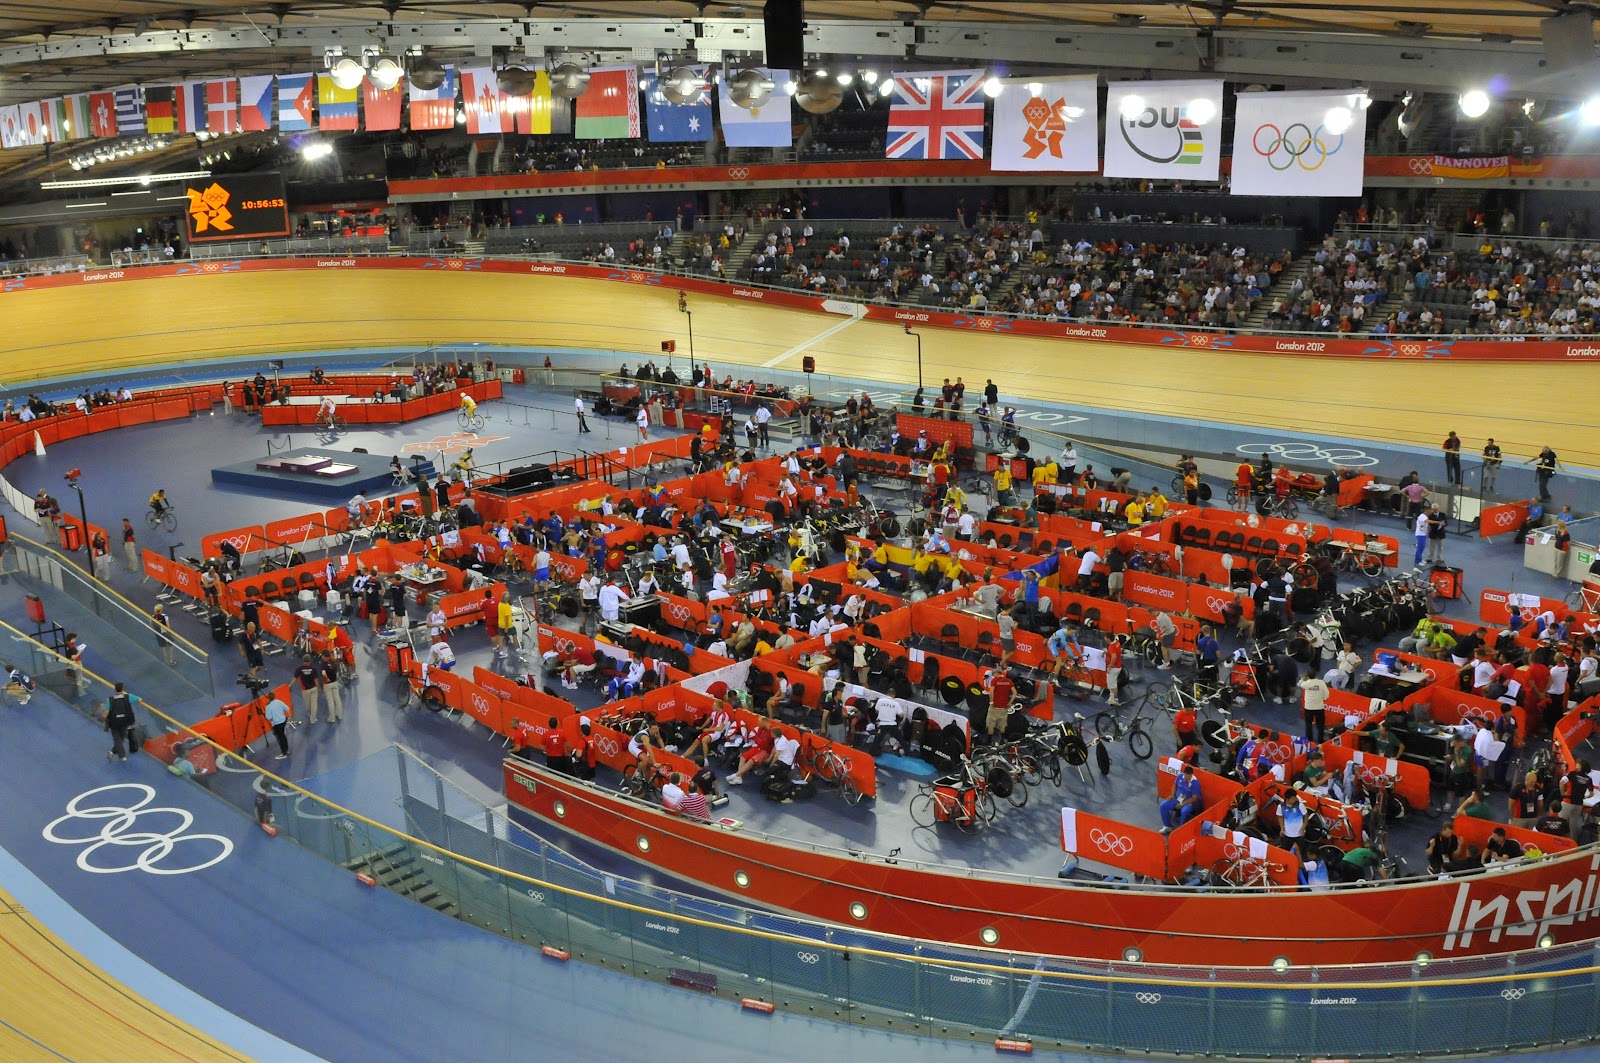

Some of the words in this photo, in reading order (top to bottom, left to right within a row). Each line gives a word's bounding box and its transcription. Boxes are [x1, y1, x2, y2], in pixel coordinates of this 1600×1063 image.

[1434, 155, 1509, 169] HANNOVER
[242, 199, 284, 210] 10:56:53
[531, 264, 552, 273] London
[553, 265, 566, 274] 2012
[83, 273, 108, 282] London
[109, 271, 124, 279] 2012
[732, 287, 751, 297] London
[752, 290, 764, 299] 2012
[895, 311, 915, 320] London
[916, 313, 929, 322] 2012
[1066, 326, 1090, 337] London
[1091, 328, 1107, 338] 2012
[1275, 340, 1305, 350] London
[1306, 342, 1326, 352] 2012
[277, 526, 300, 537] London
[1133, 582, 1158, 595] London
[1158, 588, 1175, 599] 2012
[453, 602, 479, 614] London
[1016, 641, 1032, 653] 2012
[1323, 702, 1351, 716] ondon
[1353, 709, 1368, 721] 201
[1168, 766, 1180, 776] GRE
[645, 920, 666, 932] London
[666, 925, 680, 934] 2012
[949, 974, 976, 984] London
[976, 977, 993, 986] 2012
[1310, 997, 1338, 1005] London
[1339, 997, 1357, 1005] 2012
